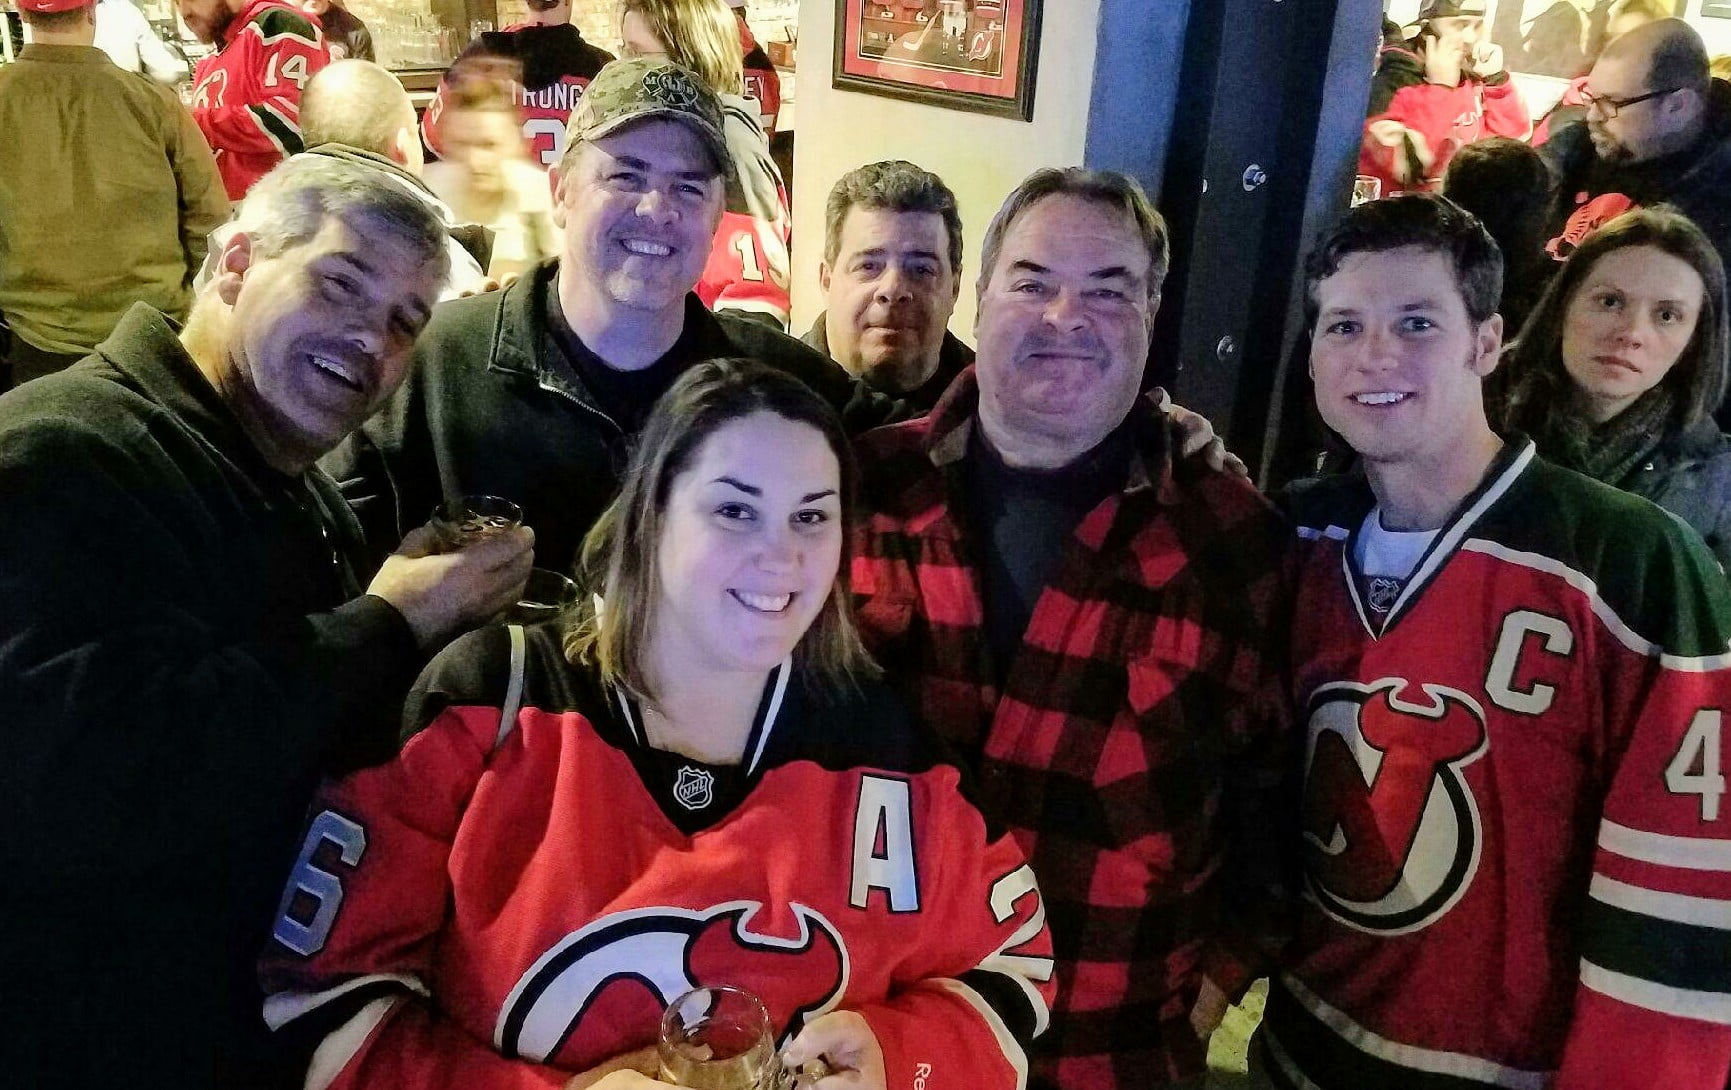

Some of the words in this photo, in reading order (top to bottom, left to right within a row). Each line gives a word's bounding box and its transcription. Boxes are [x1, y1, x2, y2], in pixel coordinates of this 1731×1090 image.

[264, 52, 310, 90] 14
[1485, 609, 1574, 716] C
[682, 779, 706, 798] NHL
[1664, 708, 1726, 821] 4
[273, 809, 367, 957] 6
[849, 774, 920, 912] A
[974, 863, 1055, 982] 2
